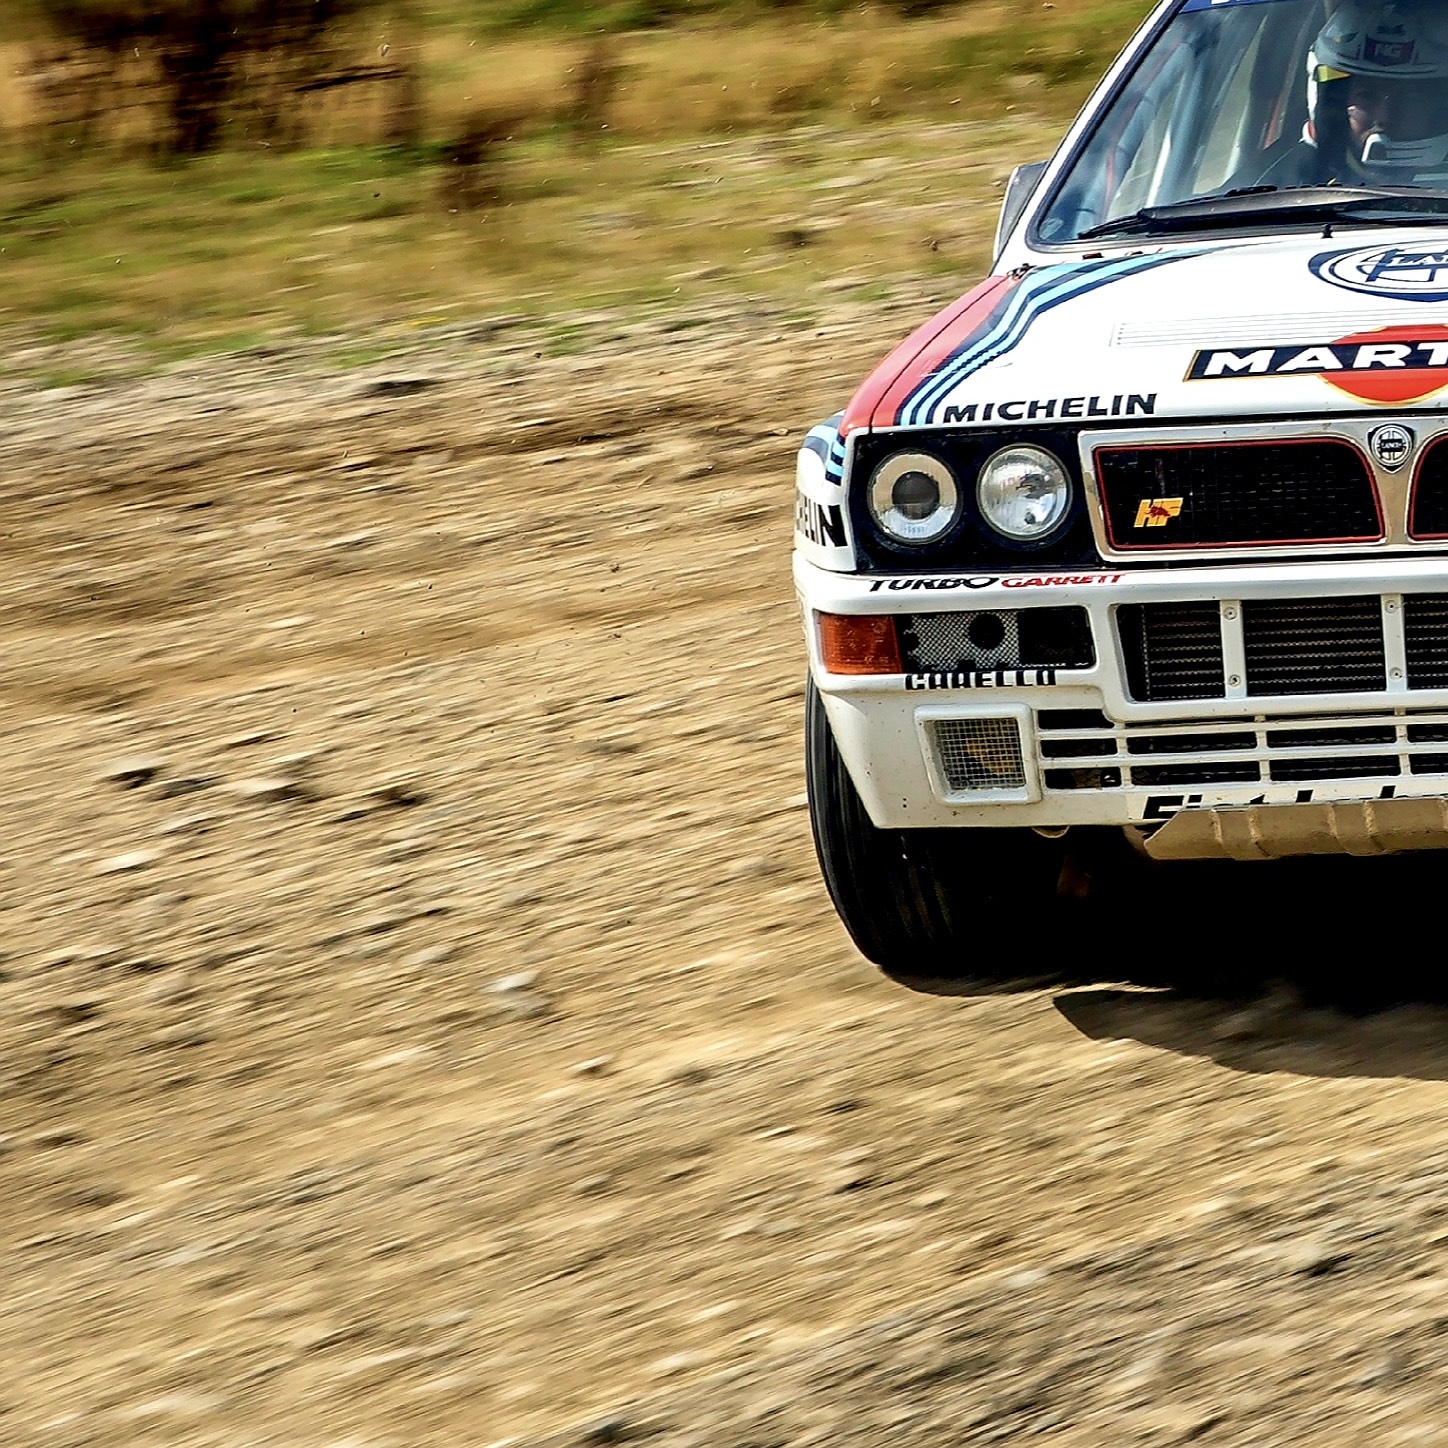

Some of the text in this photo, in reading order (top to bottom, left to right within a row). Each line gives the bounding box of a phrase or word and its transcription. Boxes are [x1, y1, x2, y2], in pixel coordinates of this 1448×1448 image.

[943, 393, 1157, 423] MICHELIN
[869, 573, 1125, 593] TURBO GARRETT
